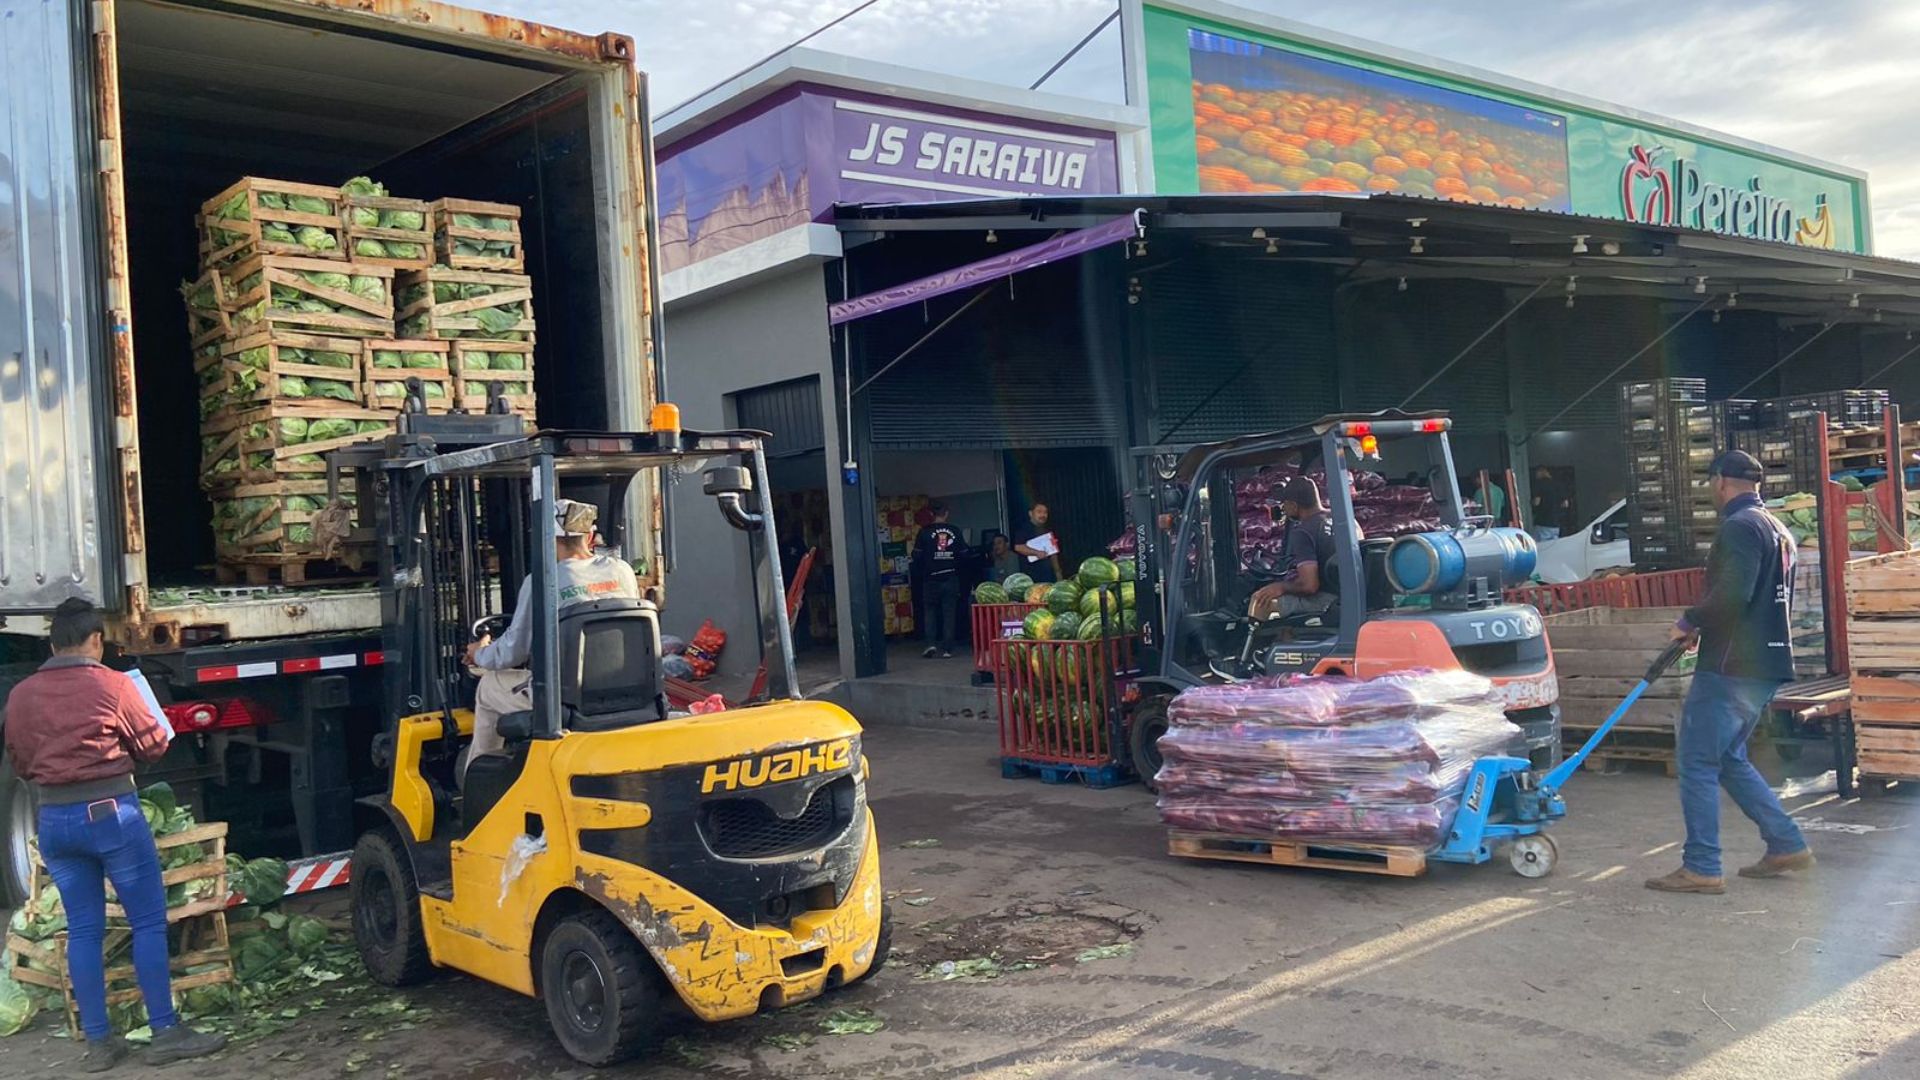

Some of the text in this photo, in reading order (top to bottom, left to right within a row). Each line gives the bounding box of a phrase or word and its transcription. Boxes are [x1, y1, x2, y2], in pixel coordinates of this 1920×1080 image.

[849, 123, 1086, 189] JS SARAIVA
[1136, 524, 1147, 580] TOYOTA
[1273, 652, 1302, 665] 25
